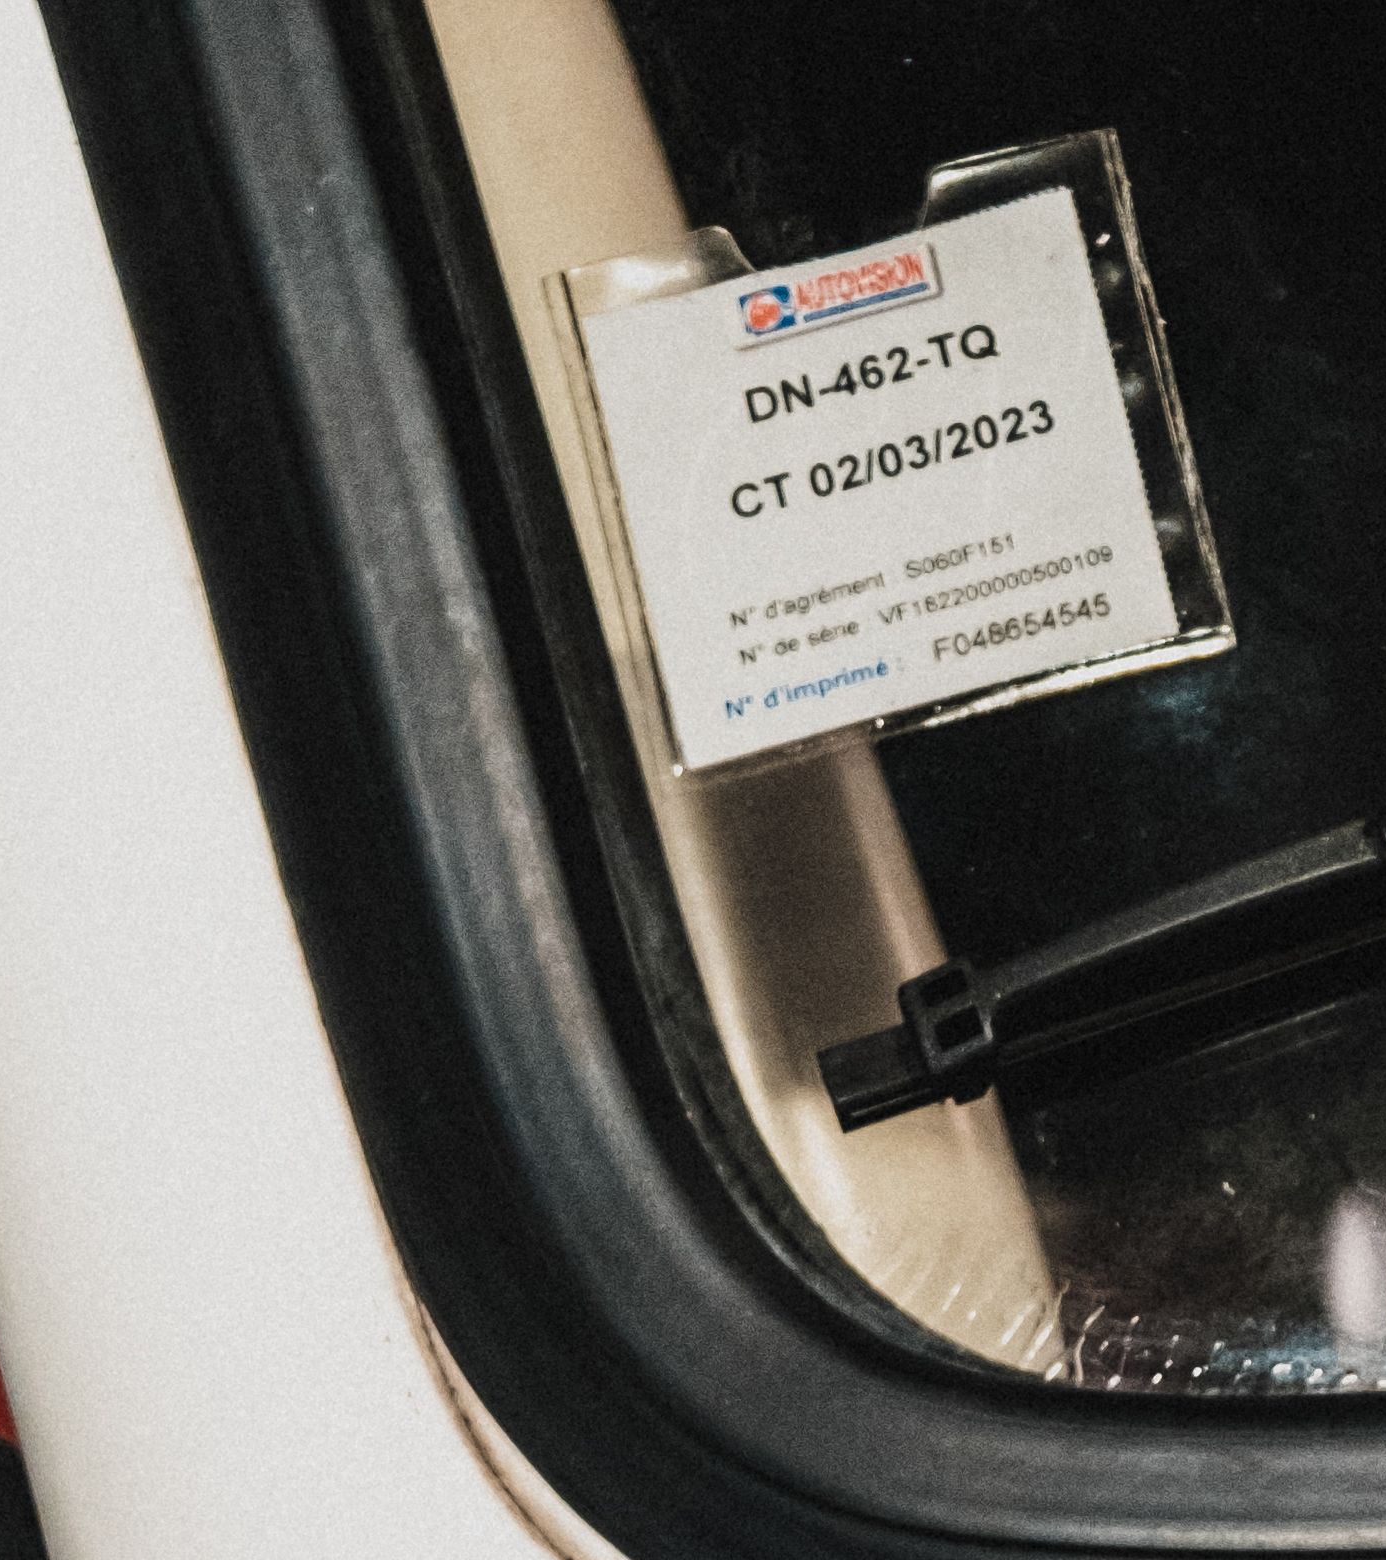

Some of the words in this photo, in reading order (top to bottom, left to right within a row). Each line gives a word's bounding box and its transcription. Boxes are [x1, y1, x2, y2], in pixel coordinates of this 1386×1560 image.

[744, 323, 1001, 424] DN-462-TQ
[731, 471, 792, 518] CT
[809, 399, 1055, 498] 02/03/2023
[774, 634, 800, 657] de
[806, 617, 860, 649] série
